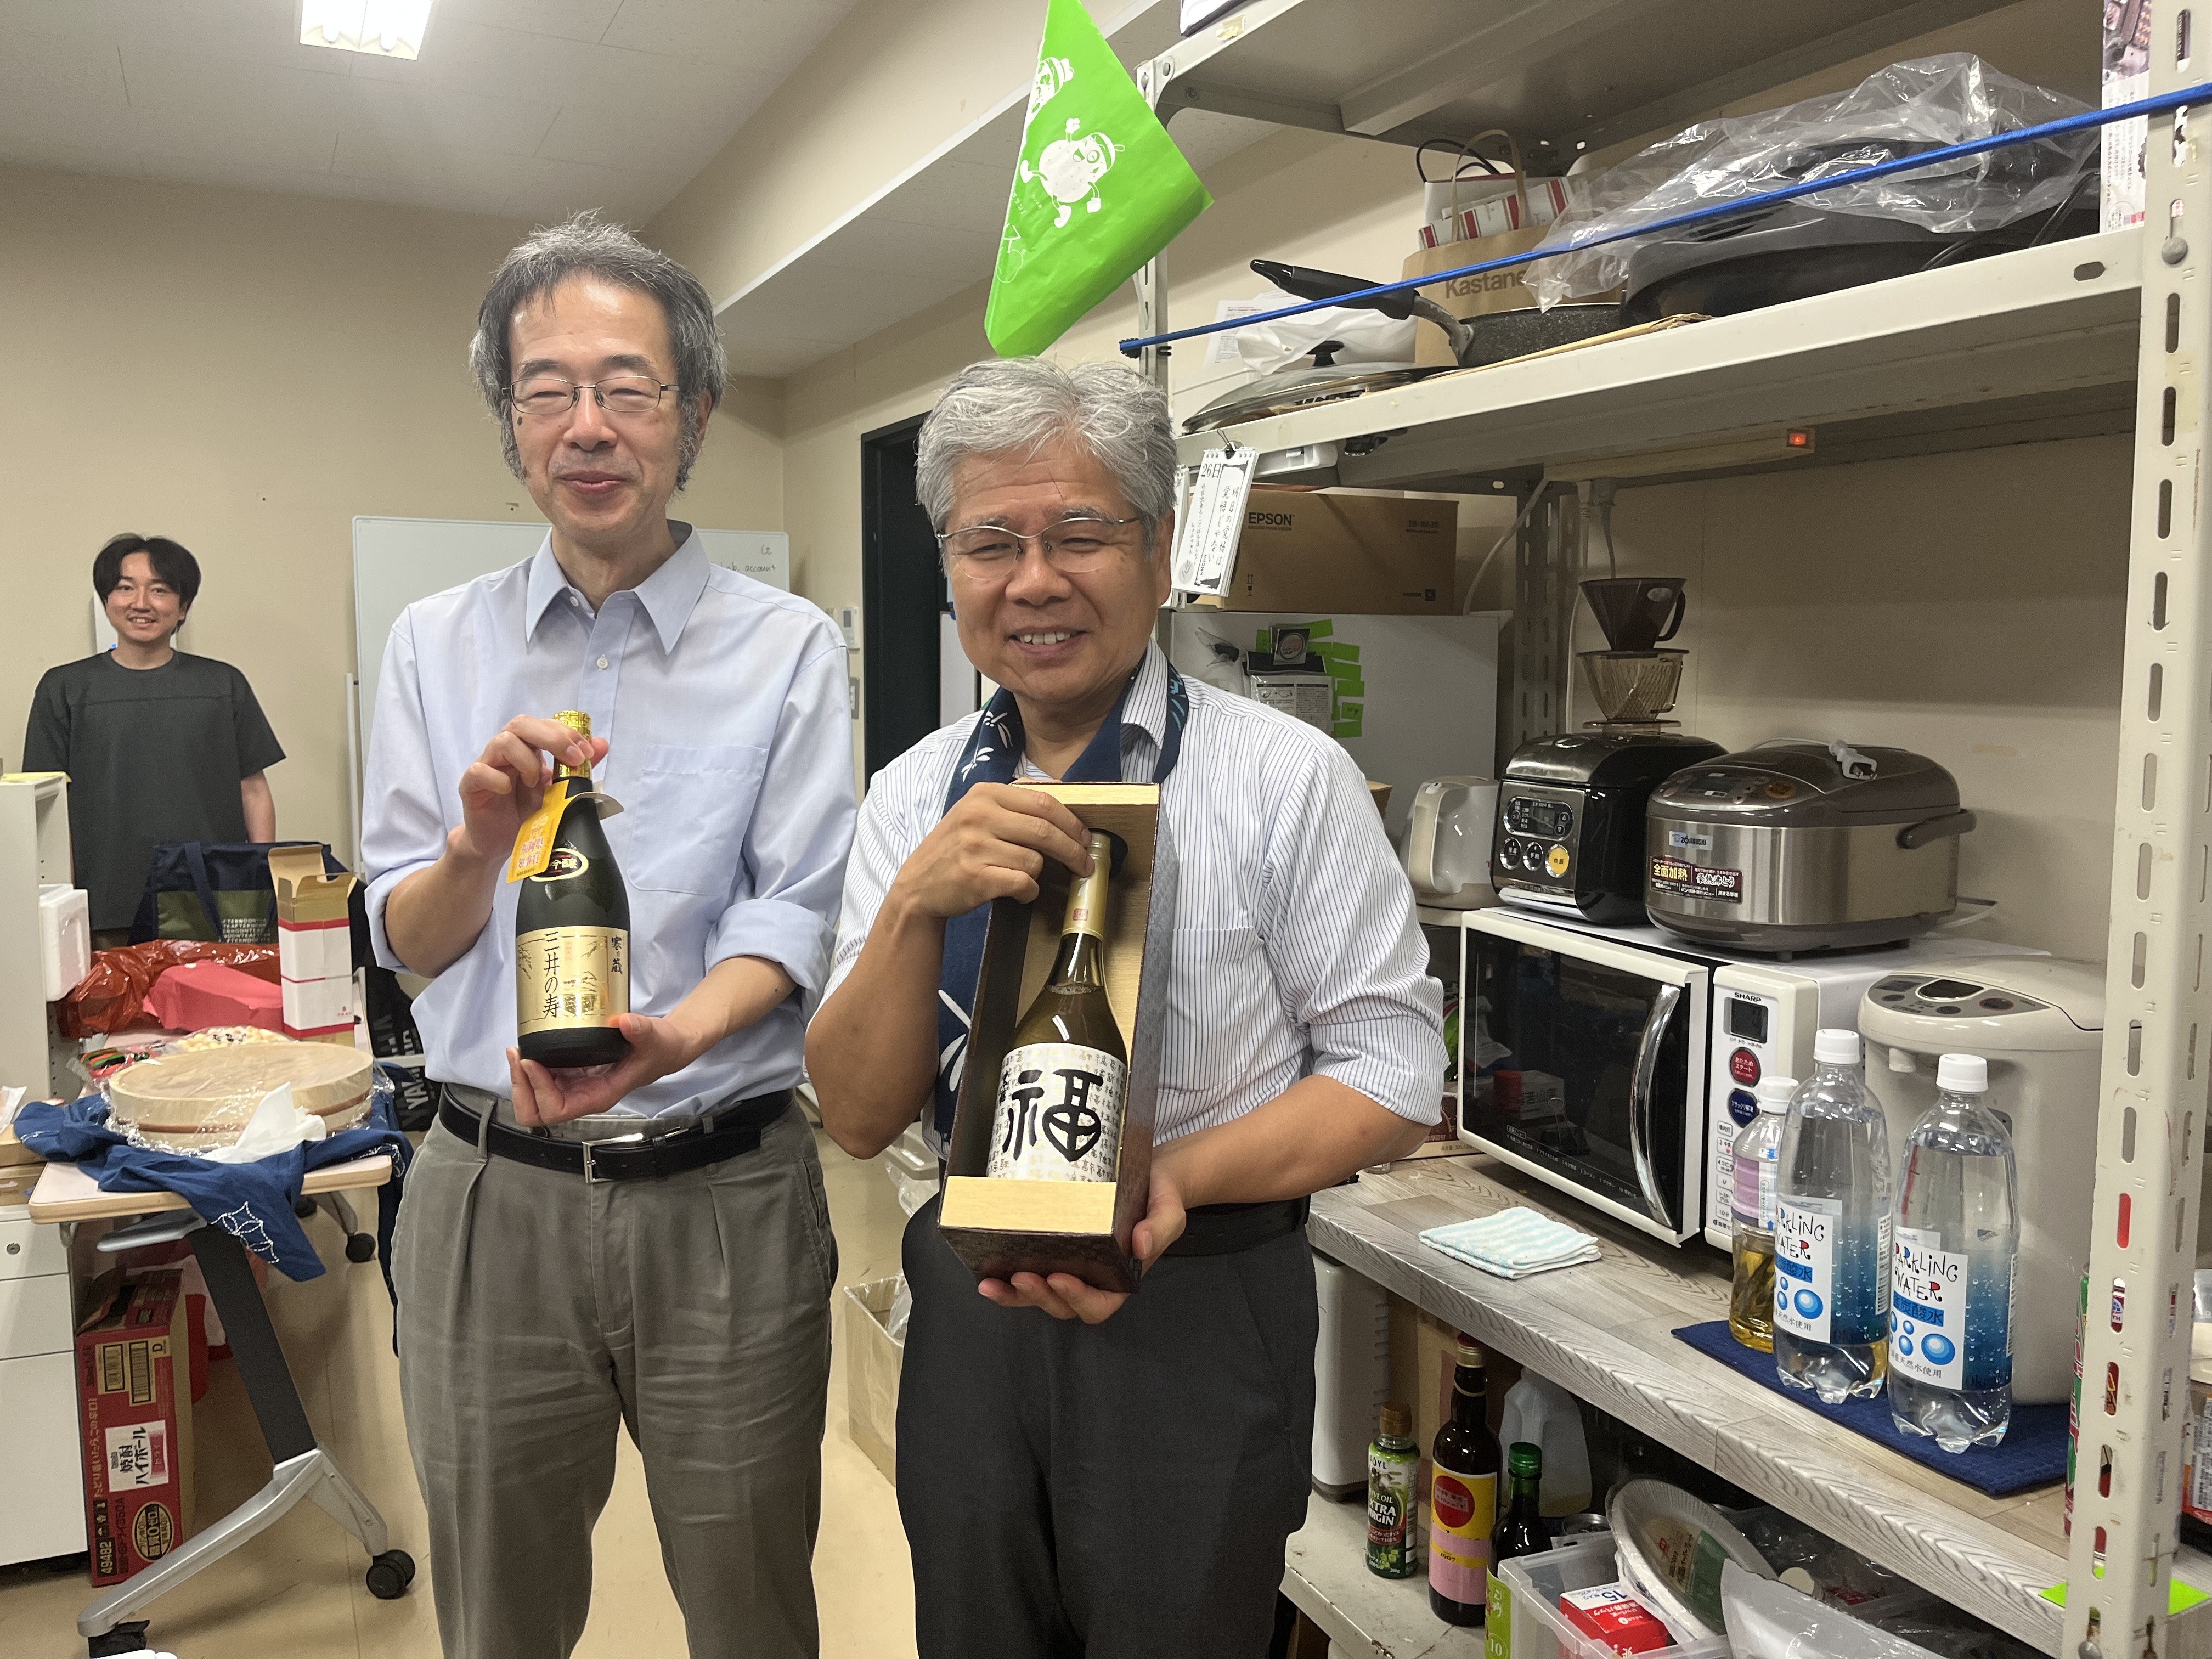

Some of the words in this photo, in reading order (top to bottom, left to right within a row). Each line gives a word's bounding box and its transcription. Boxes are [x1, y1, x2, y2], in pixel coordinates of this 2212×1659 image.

[1200, 463, 1222, 478] 26日
[1248, 512, 1292, 526] EPSON
[1653, 864, 1688, 882] 全面加熱
[542, 931, 561, 1019] 三井の寿
[1734, 992, 1762, 1003] SHARP
[1735, 1056, 1754, 1067] あたため
[1735, 1063, 1752, 1073] スタート
[1002, 1068, 1104, 1162] 福
[1895, 1266, 1943, 1302] WATER
[1775, 1310, 1812, 1332] 天然水使用
[152, 1344, 163, 1352] D
[119, 1444, 133, 1474] 焼酎
[132, 1426, 149, 1485] ハイボール
[153, 1444, 163, 1466] ドライ
[1381, 1494, 1393, 1504] OIL
[99, 1541, 113, 1575] 49482
[1440, 1552, 1456, 1563] 1907
[1601, 1590, 1628, 1601] 15
[1491, 1639, 1503, 1657] 10
